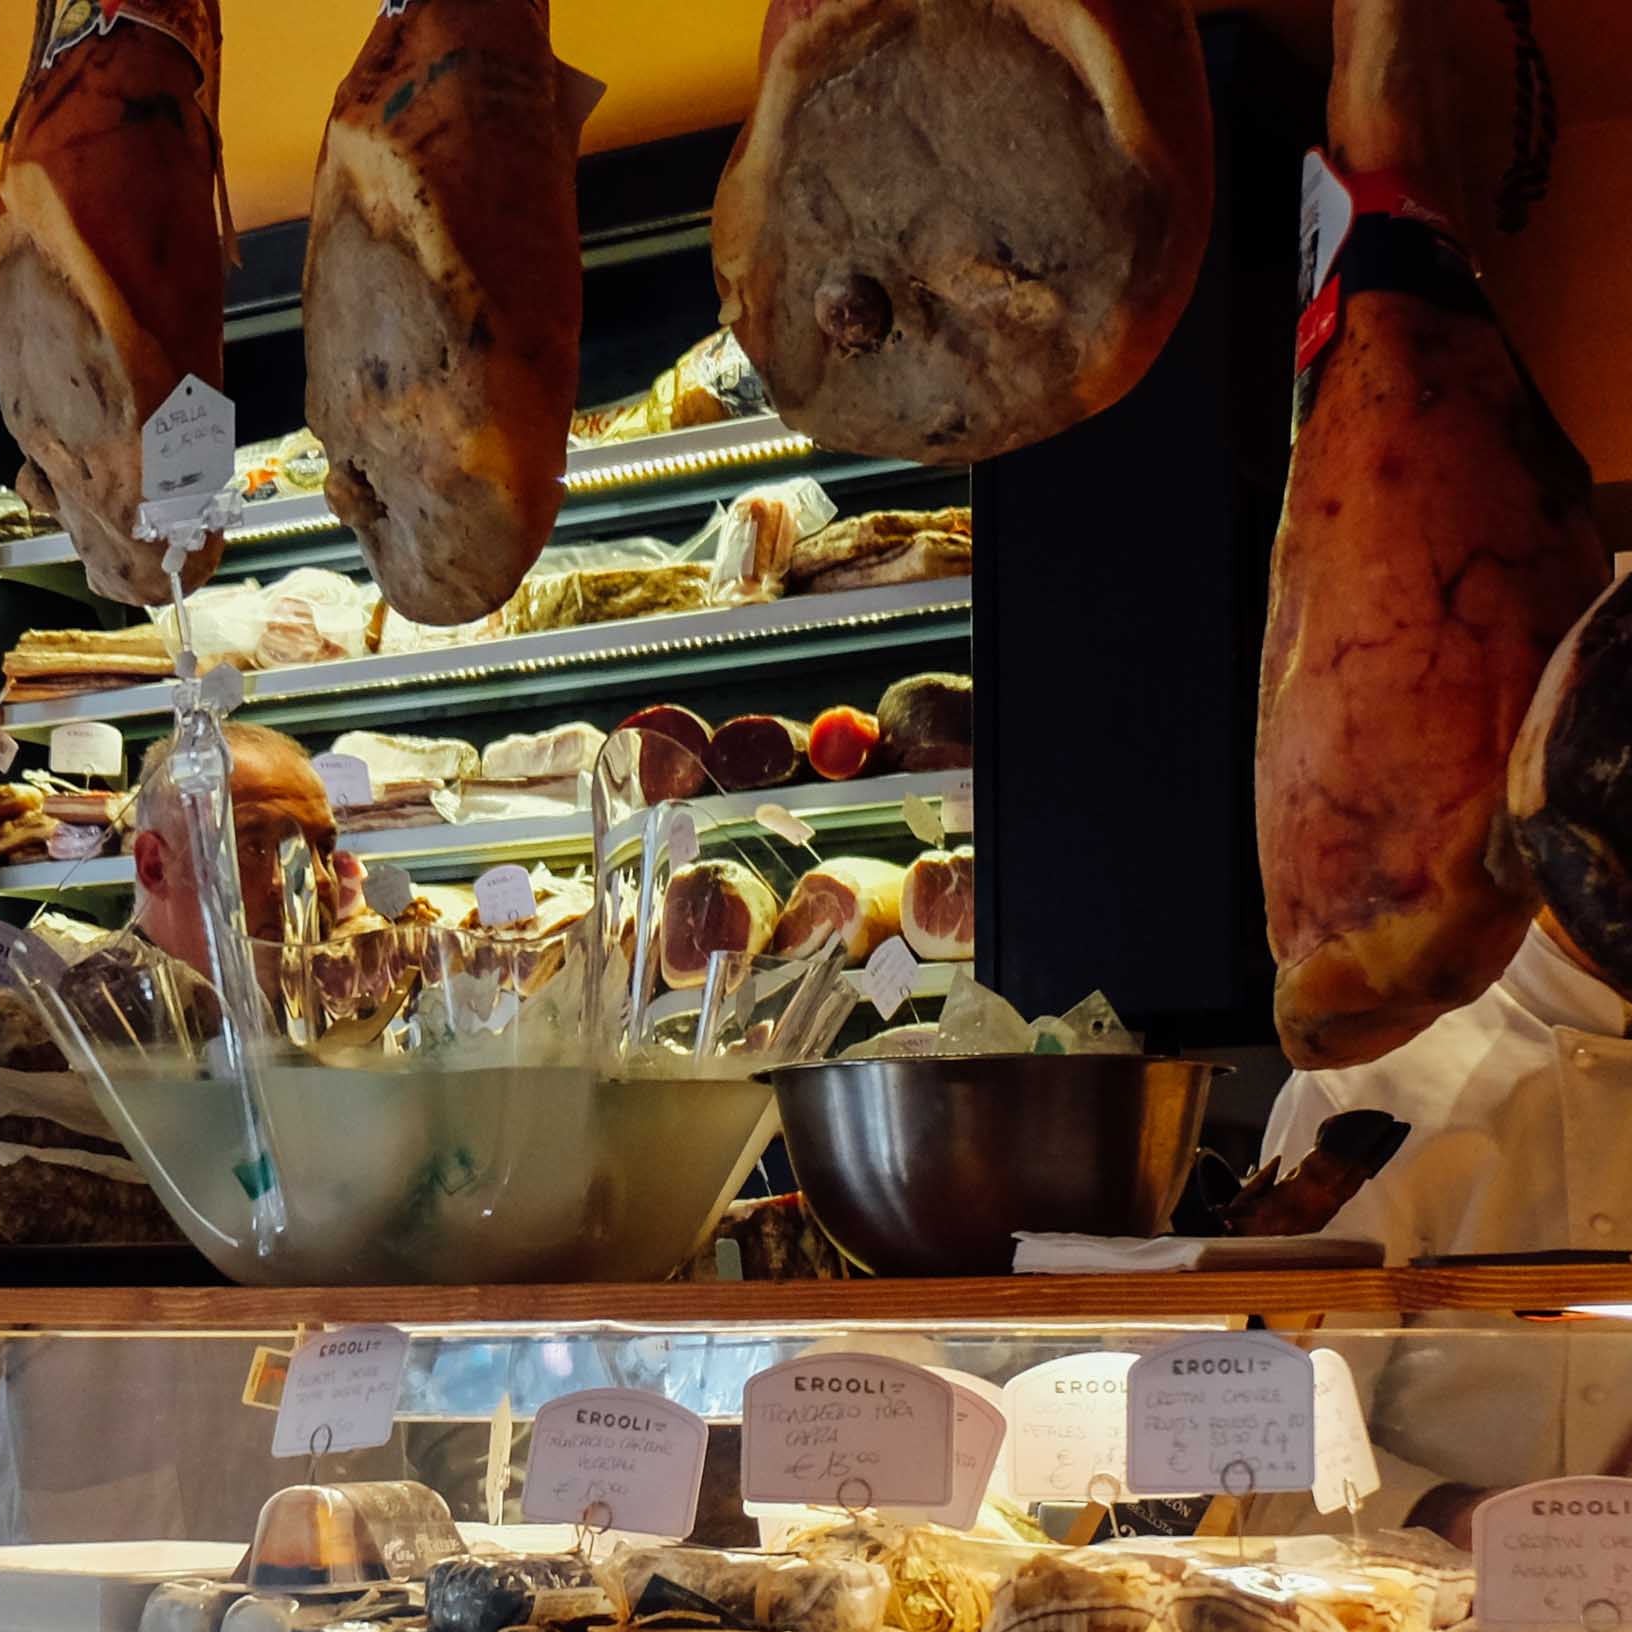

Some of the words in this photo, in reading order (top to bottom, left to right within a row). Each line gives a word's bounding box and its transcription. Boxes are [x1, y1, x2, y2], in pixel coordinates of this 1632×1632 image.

[319, 1341, 373, 1358] ERCOLI
[1172, 1358, 1254, 1376] ERCOLI
[794, 1376, 887, 1394] ERCOLI
[576, 1410, 650, 1431] ERCOLI
[1531, 1500, 1632, 1516] ERCOLI
